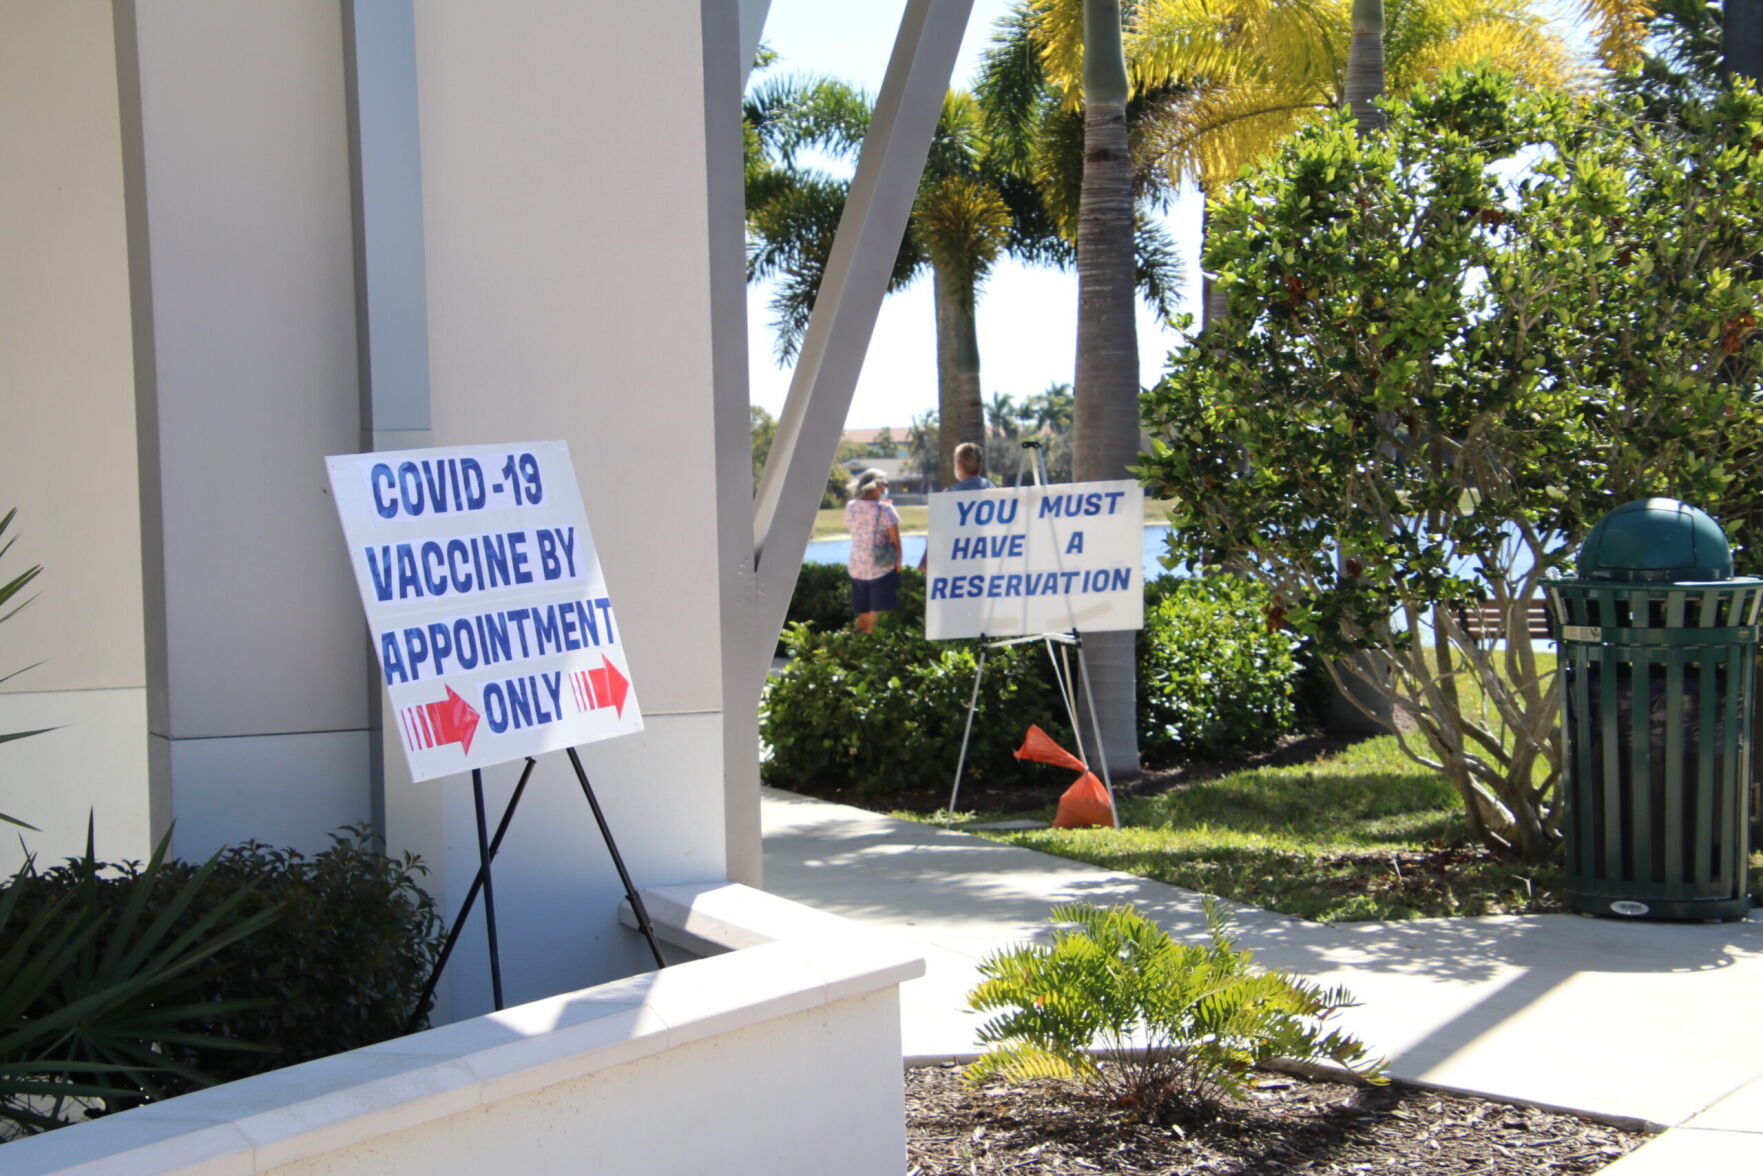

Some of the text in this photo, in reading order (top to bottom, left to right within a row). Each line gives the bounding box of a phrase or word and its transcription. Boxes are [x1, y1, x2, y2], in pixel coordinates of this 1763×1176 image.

[956, 492, 1124, 526] YOU MUST
[365, 527, 576, 601] VACCINE BY
[951, 532, 1084, 560] HAVE A
[930, 567, 1131, 600] RESERVATION
[380, 597, 615, 686] APPOINTMENT
[482, 670, 564, 734] ONLY
